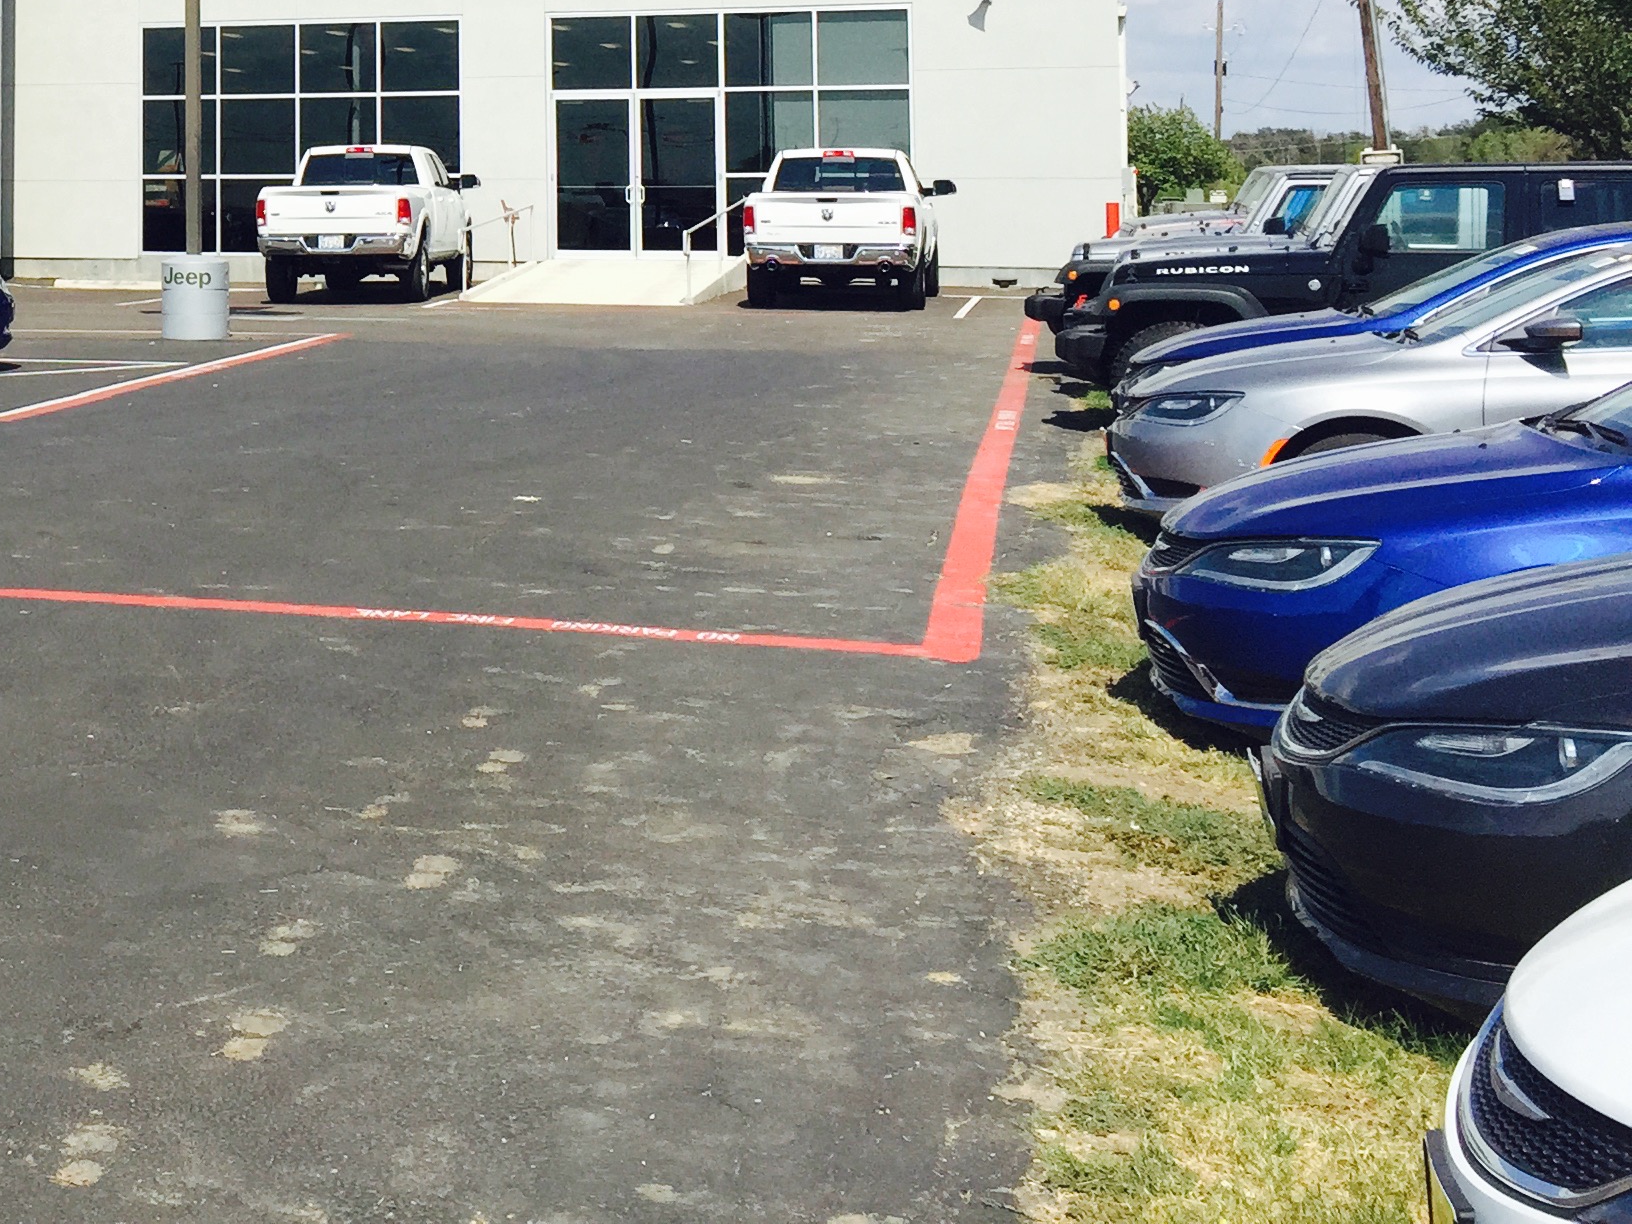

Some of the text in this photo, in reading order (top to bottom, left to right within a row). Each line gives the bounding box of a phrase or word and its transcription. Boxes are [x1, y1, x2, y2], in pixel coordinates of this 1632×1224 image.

[163, 266, 212, 289] Jeep
[1155, 264, 1251, 275] RUBICON
[352, 608, 741, 643] NO PARKING FIRE LANE
